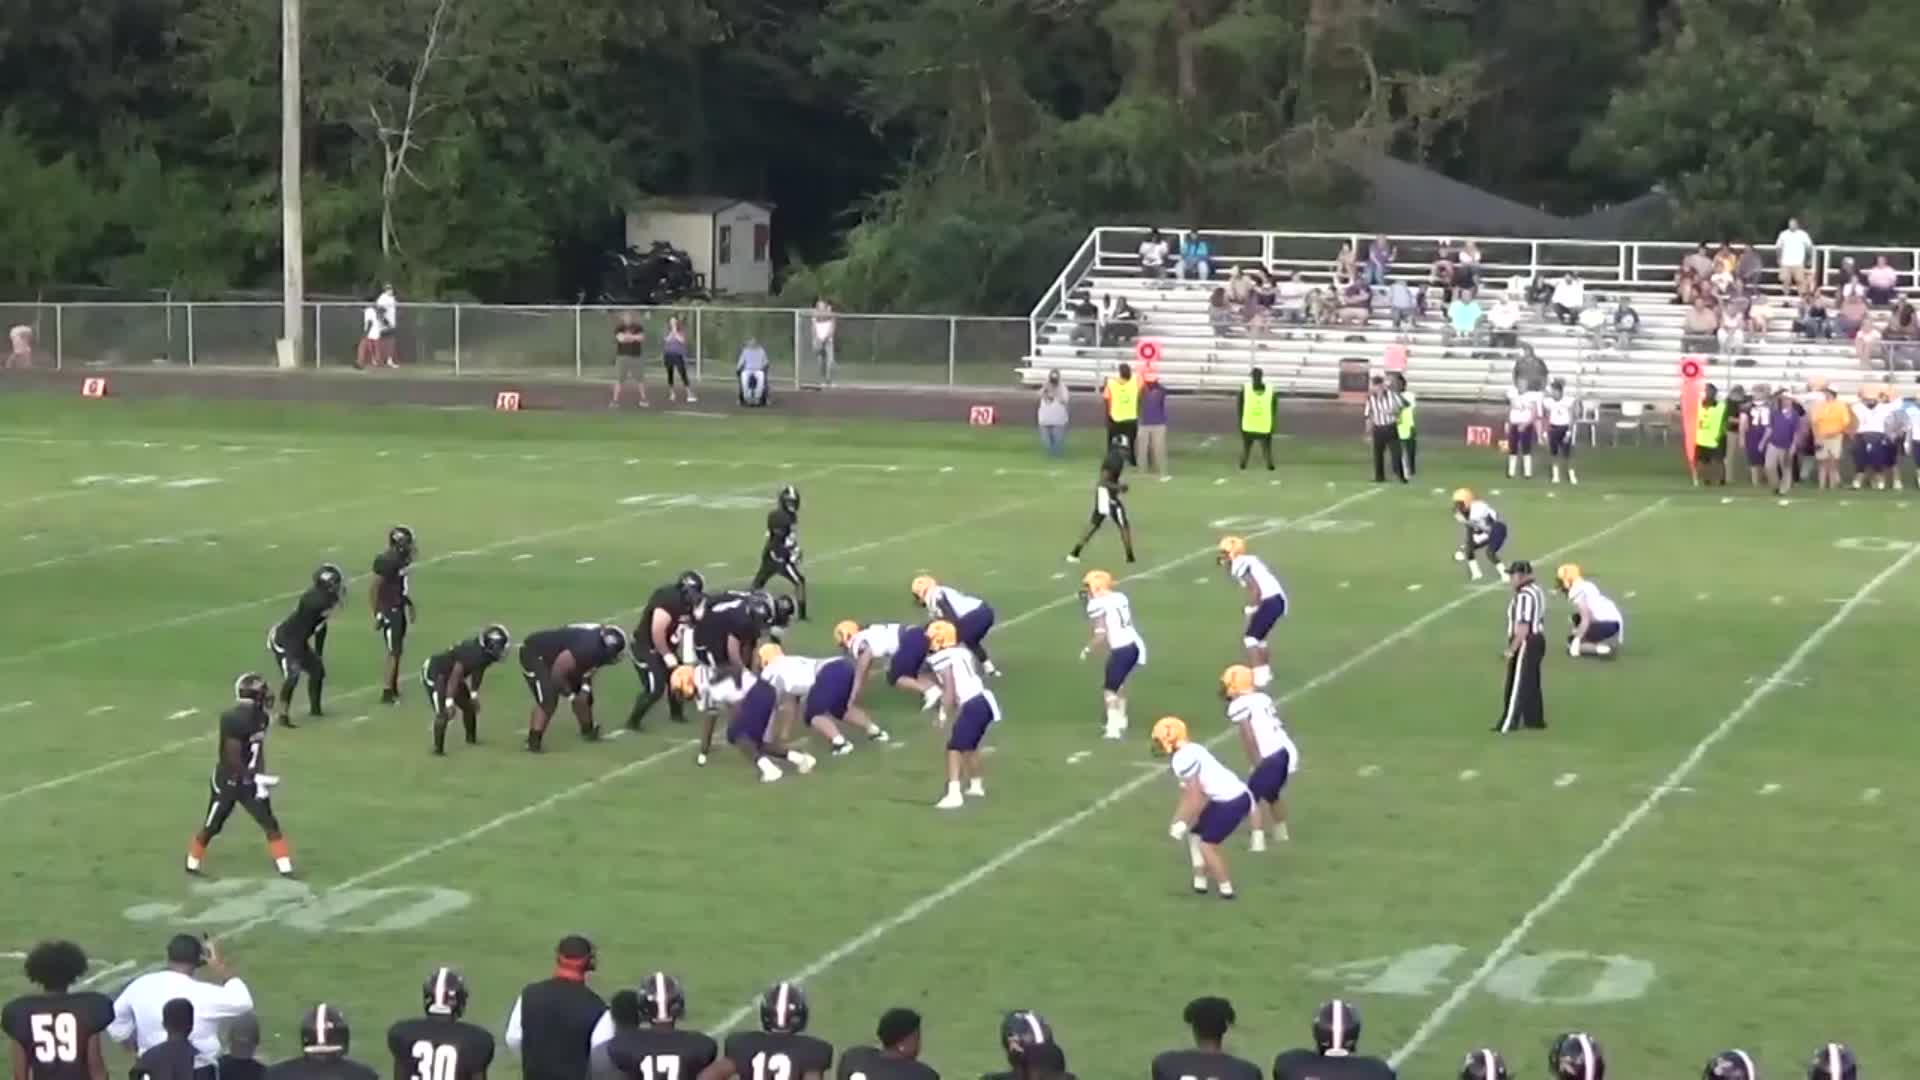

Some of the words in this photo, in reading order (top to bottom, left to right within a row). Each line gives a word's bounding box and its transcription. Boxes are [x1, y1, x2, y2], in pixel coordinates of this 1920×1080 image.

[971, 407, 992, 424] 20
[30, 1012, 78, 1062] 59
[411, 1039, 457, 1080] 30
[640, 1054, 680, 1080] 17
